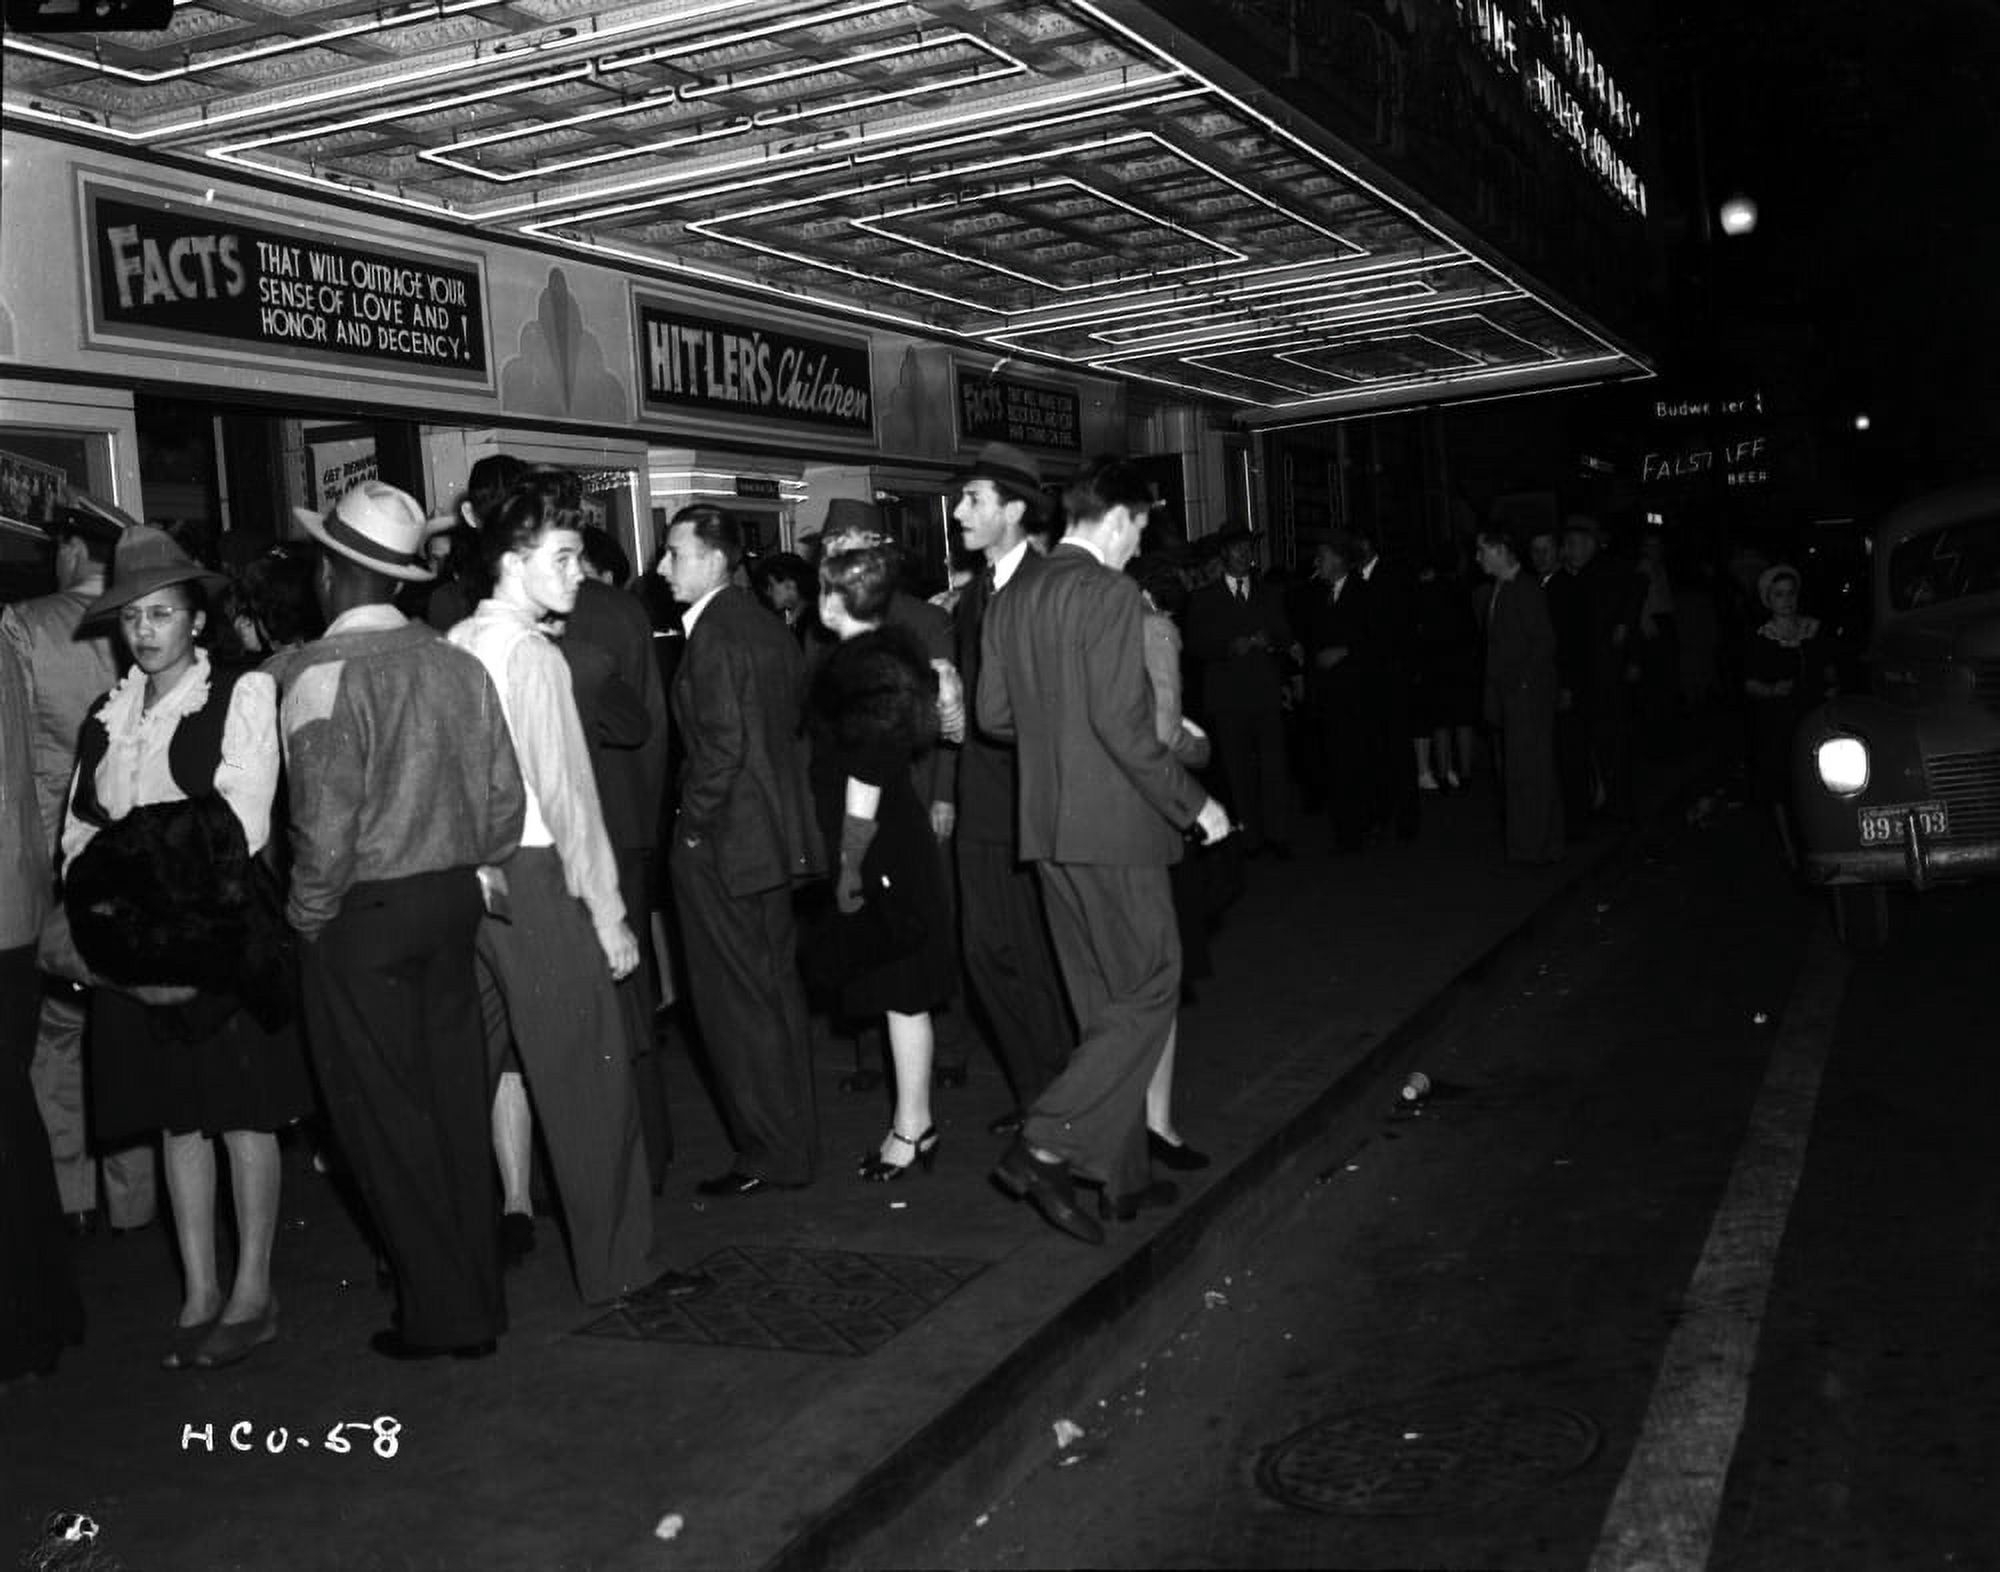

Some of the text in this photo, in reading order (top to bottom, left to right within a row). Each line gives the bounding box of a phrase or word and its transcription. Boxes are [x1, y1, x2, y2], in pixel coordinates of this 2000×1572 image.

[107, 224, 468, 309] FACTS THAT WILL OUTRAGE YOUR
[258, 277, 450, 331] SENSE OF LOVE AND
[261, 308, 472, 361] HONOR AND DECENCY!
[647, 319, 869, 421] HITLER'S Children
